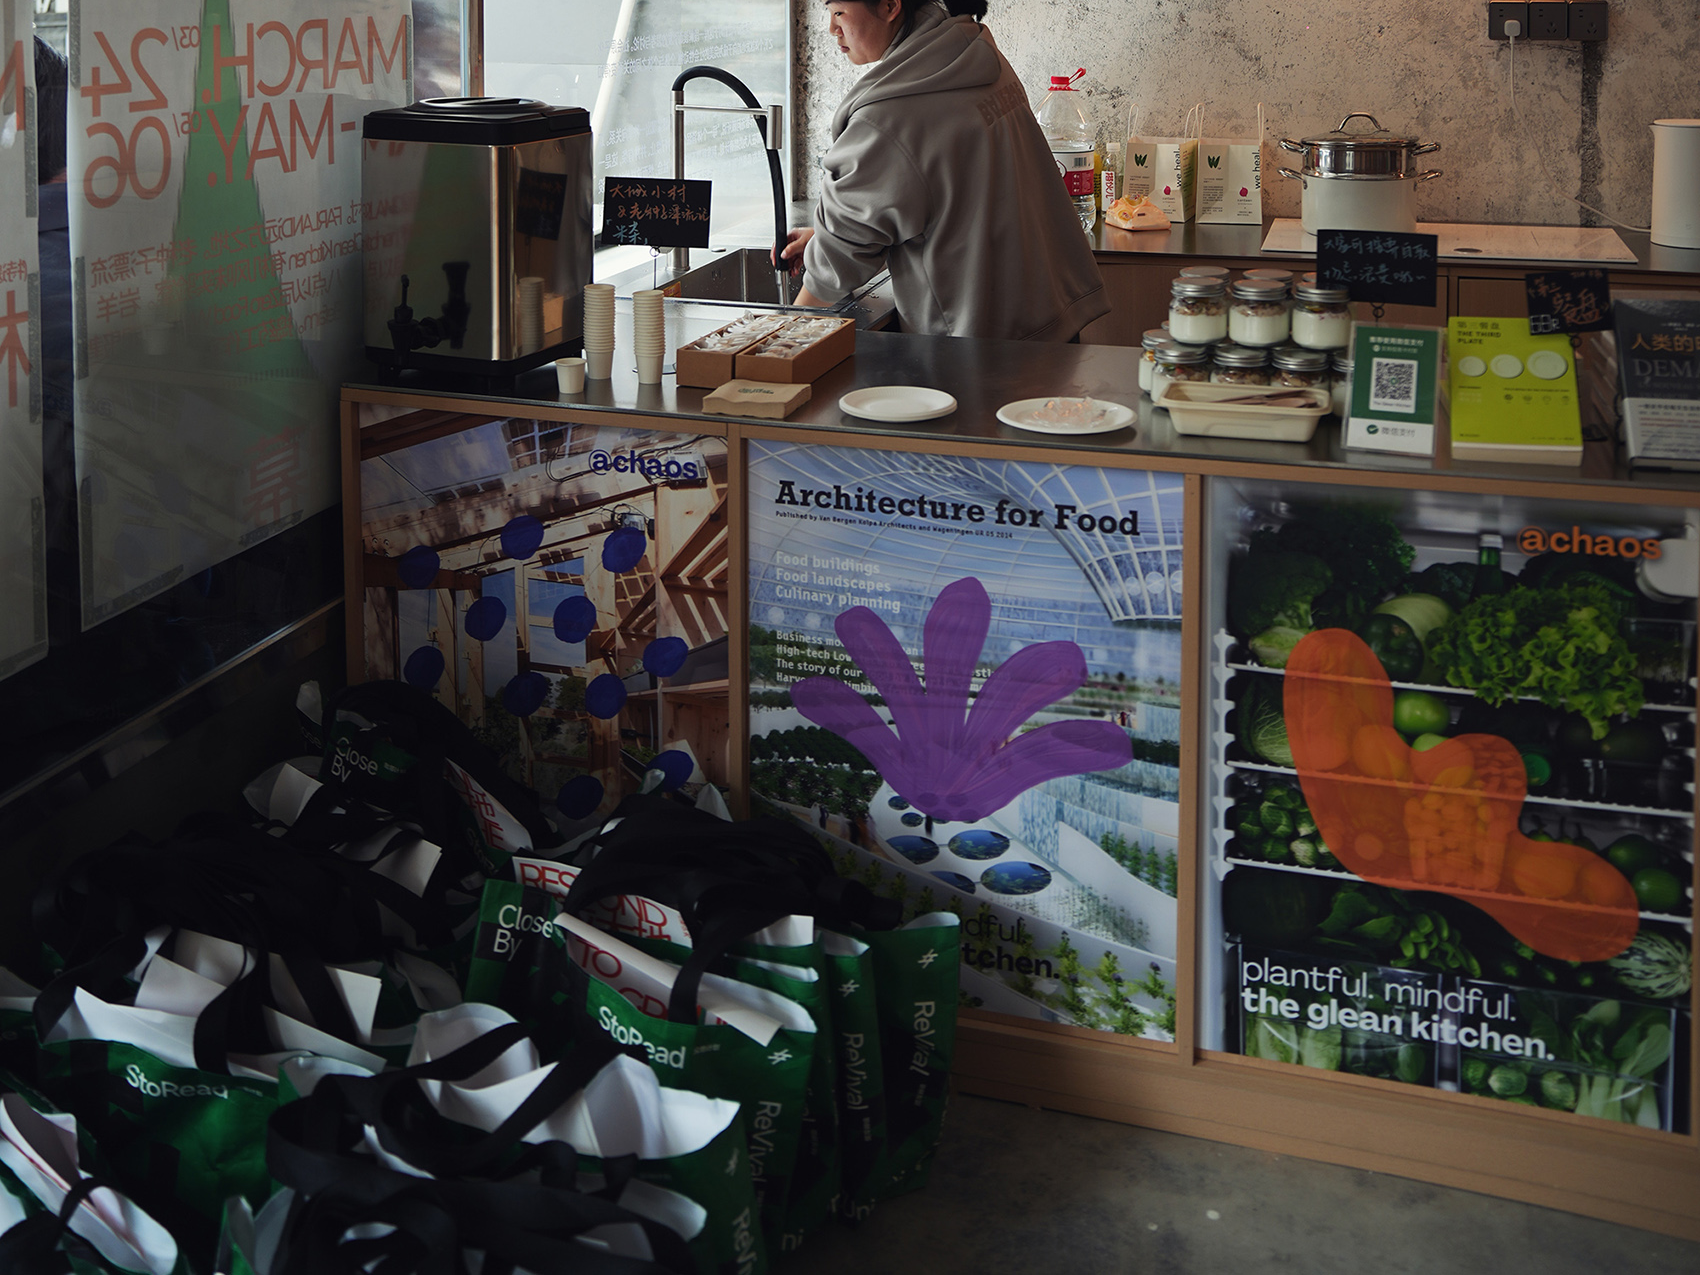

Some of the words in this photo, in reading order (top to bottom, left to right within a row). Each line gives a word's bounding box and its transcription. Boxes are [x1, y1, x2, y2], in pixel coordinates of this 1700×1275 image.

[774, 479, 986, 524] Architecture
[994, 498, 1045, 528] for
[1053, 503, 1141, 537] Food
[775, 510, 808, 522] Published
[808, 513, 818, 522] by
[819, 514, 832, 523] Van
[832, 515, 858, 527] Bergen
[878, 519, 917, 531] Architects
[918, 523, 932, 531] and
[776, 551, 809, 567] Food
[812, 555, 881, 577] buildings
[776, 568, 808, 584] Food
[811, 570, 893, 593] landscapes
[775, 585, 835, 606] Culinary
[838, 592, 902, 615] planning
[776, 630, 823, 645] Business
[776, 644, 830, 661] High-tech
[776, 658, 794, 669] The
[797, 661, 827, 674] story
[829, 665, 841, 675] of
[843, 668, 864, 678] our
[335, 736, 378, 776] Close
[498, 904, 554, 939] Close
[492, 929, 523, 962] By
[1242, 959, 1375, 1000] plantful.
[1384, 977, 1516, 1022] mindful.
[911, 998, 936, 1077] ReVival
[1241, 988, 1300, 1018] the
[1306, 1000, 1403, 1038] glean
[1410, 1007, 1555, 1061] kitchen.
[842, 1031, 870, 1112] ReVival
